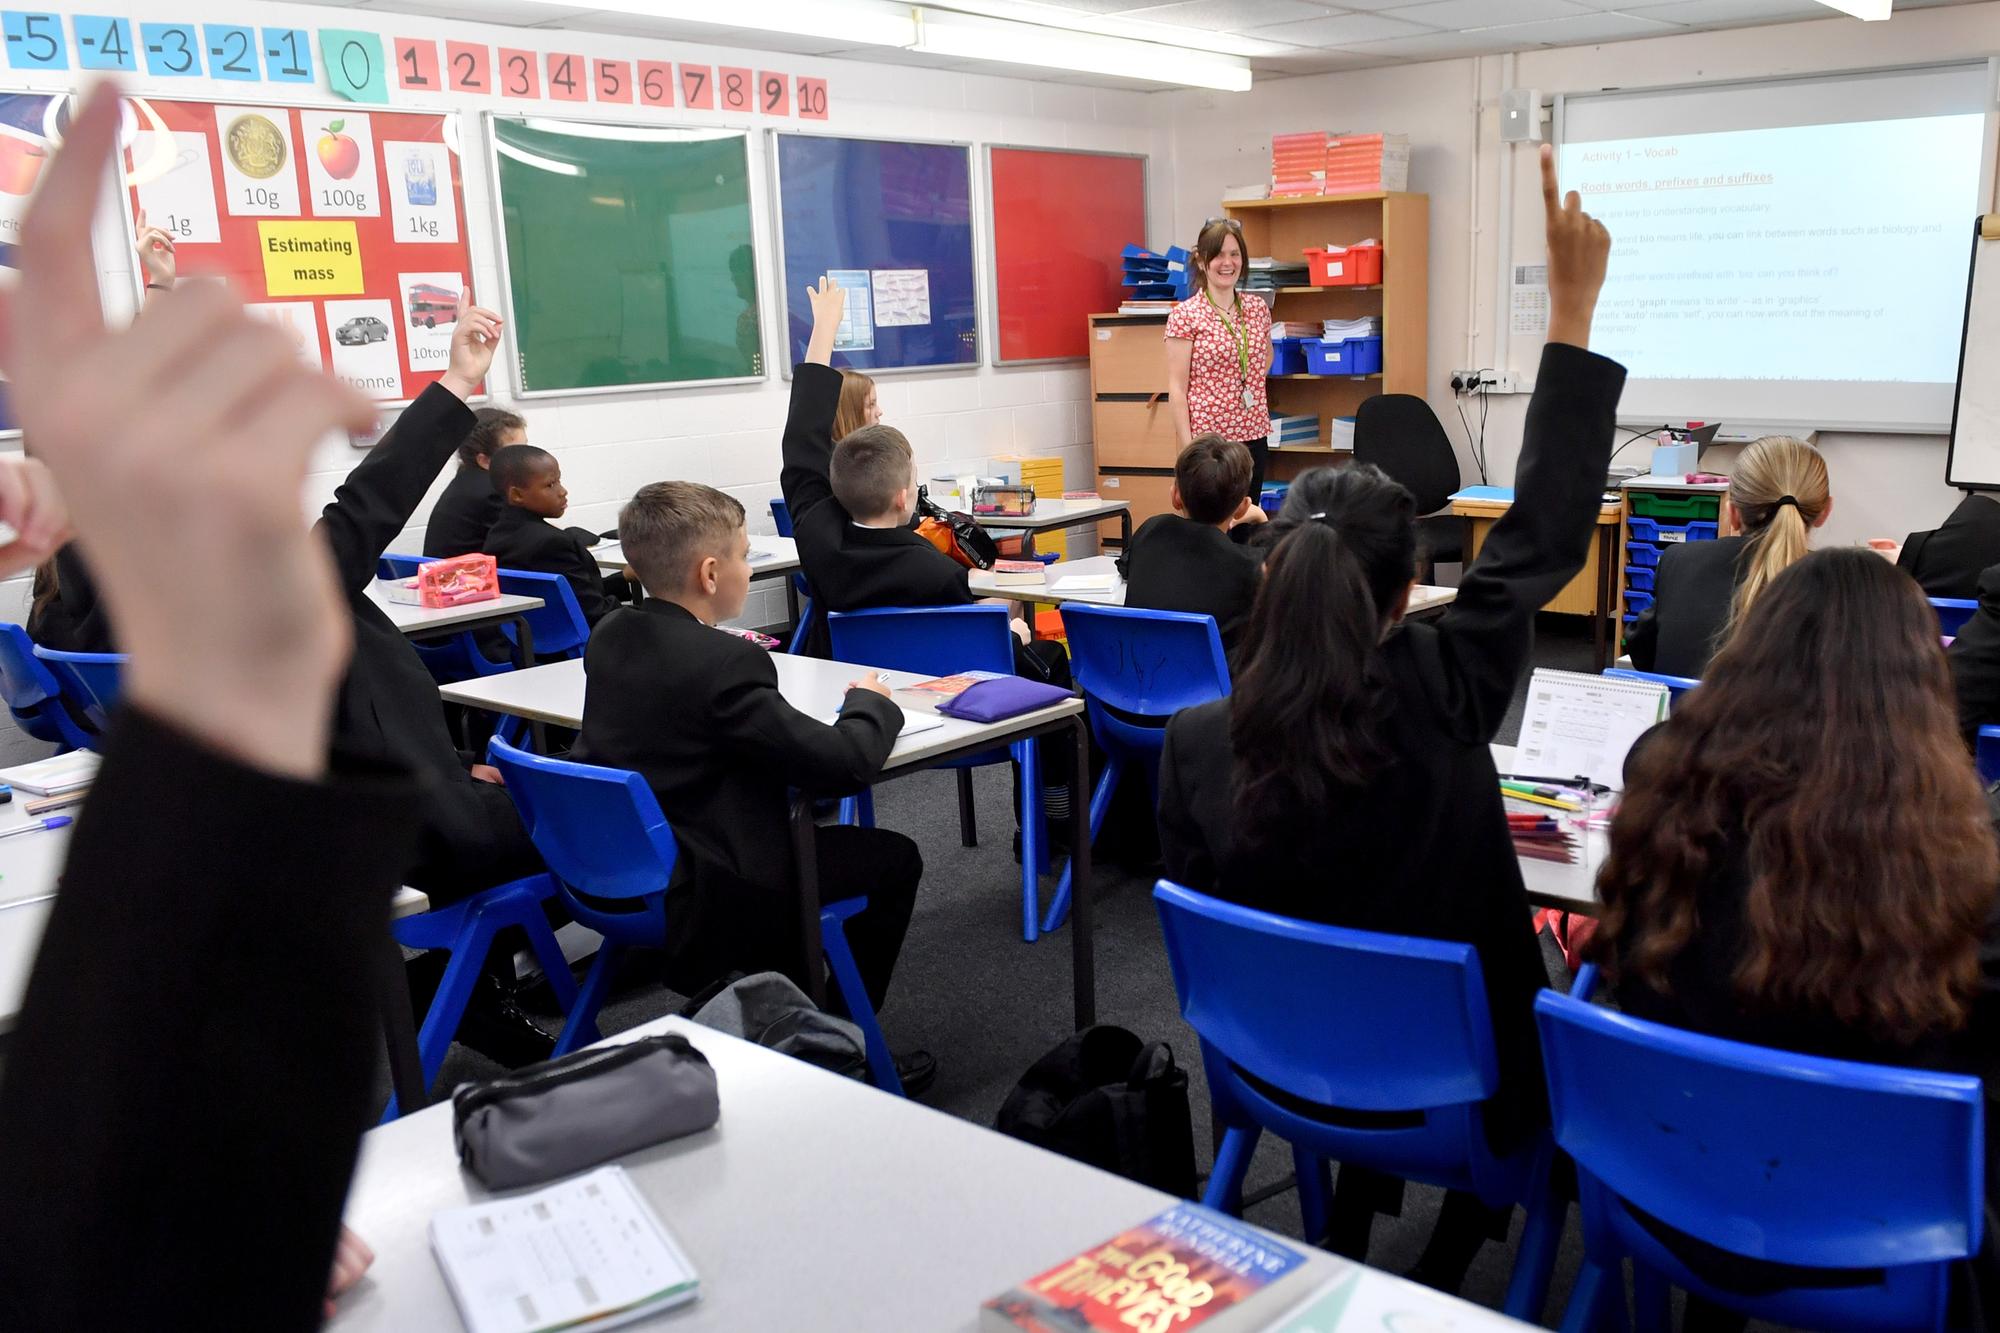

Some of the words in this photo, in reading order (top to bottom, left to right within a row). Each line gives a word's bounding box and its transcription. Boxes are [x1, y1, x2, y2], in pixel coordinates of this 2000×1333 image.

[7, 16, 58, 62] -5
[82, 19, 128, 65] -4
[149, 29, 193, 73] -3
[211, 31, 252, 73] -2
[268, 30, 308, 76] -1
[341, 40, 370, 90] 0
[403, 46, 428, 85] 1
[453, 52, 481, 87] 2
[507, 55, 530, 95] 3
[552, 54, 577, 95] 4
[601, 63, 619, 95] 5
[644, 68, 663, 100] 6
[685, 72, 705, 103] 7
[726, 73, 744, 107] 8
[765, 78, 782, 111] 9
[799, 82, 826, 114] 10
[1582, 151, 1622, 163] Activity
[1644, 146, 1679, 158] Vocab
[1655, 176, 1699, 189] prefixes
[1703, 174, 1724, 185] and
[1728, 171, 1774, 184] suffixes
[245, 188, 280, 210] 10g
[322, 189, 366, 211] 100g
[168, 214, 192, 237] 1g
[409, 215, 439, 237] 1kg
[1922, 222, 1942, 233] and
[268, 237, 353, 256] Estimating
[294, 268, 335, 280] mass
